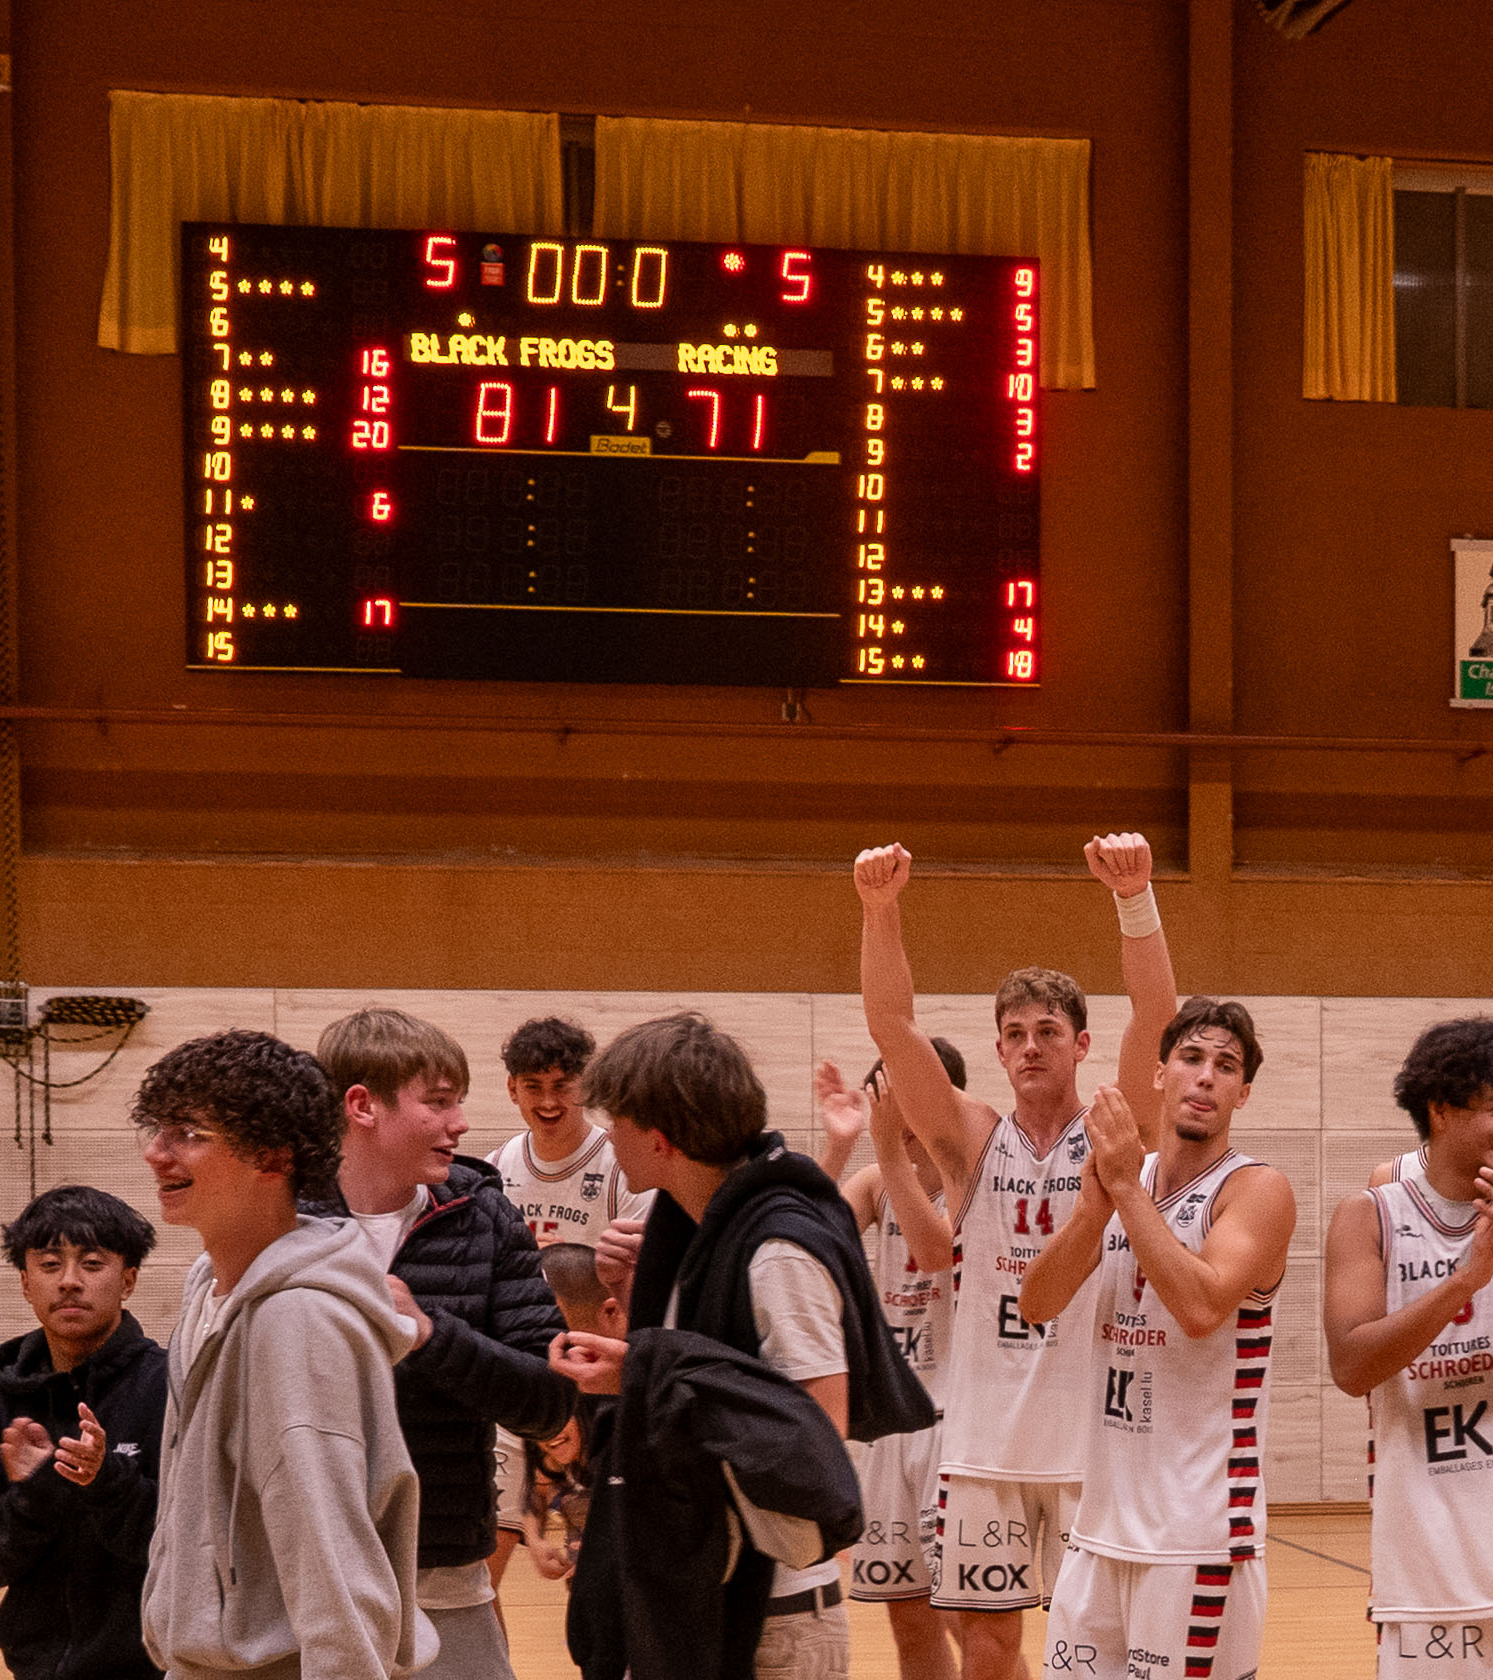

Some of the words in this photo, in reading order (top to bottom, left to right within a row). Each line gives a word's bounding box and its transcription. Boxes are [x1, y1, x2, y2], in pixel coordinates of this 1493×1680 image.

[209, 236, 229, 263] 4
[426, 236, 456, 287] 5
[210, 271, 229, 300] 5
[783, 251, 811, 303] 5
[867, 265, 885, 287] 4
[1015, 269, 1033, 297] 9
[210, 307, 229, 337] 6
[867, 299, 885, 326] 5
[1015, 303, 1033, 331] 5
[213, 343, 230, 371] 7
[411, 332, 509, 366] BLACK
[520, 337, 616, 371] FROGS
[678, 343, 778, 376] RACING
[867, 334, 885, 361] 6
[1017, 339, 1032, 367] 3
[362, 349, 388, 376] 16
[211, 379, 230, 409] 8
[867, 369, 883, 393] 7
[1008, 373, 1033, 402] 10
[363, 386, 387, 413] 12
[476, 382, 557, 443] 81
[606, 385, 636, 431] 4
[211, 415, 231, 445] 9
[688, 389, 764, 449] 71
[867, 404, 884, 430] 8
[1017, 408, 1033, 436] 3
[353, 421, 389, 449] 20
[867, 439, 884, 465] 9
[1016, 443, 1033, 471] 2
[205, 452, 231, 481] 10
[858, 474, 884, 500] 10
[206, 489, 231, 514] 11
[373, 493, 391, 520] 6
[858, 509, 884, 533] 11
[207, 524, 232, 553] 12
[858, 544, 885, 570] 12
[207, 560, 233, 589] 13
[858, 579, 885, 605] 13
[1008, 581, 1033, 608] 17
[207, 596, 233, 623] 14
[364, 600, 392, 625] 17
[858, 614, 885, 637] 14
[1013, 616, 1033, 642] 4
[208, 632, 234, 661] 15
[858, 648, 885, 674] 15
[1008, 650, 1033, 678] 18
[549, 1204, 590, 1226] FROGS
[1013, 1198, 1054, 1236] 14
[1430, 1335, 1492, 1358] TOITURES
[853, 1558, 916, 1585] KOX
[958, 1563, 1031, 1592] KOX
[1043, 1640, 1097, 1675] &R
